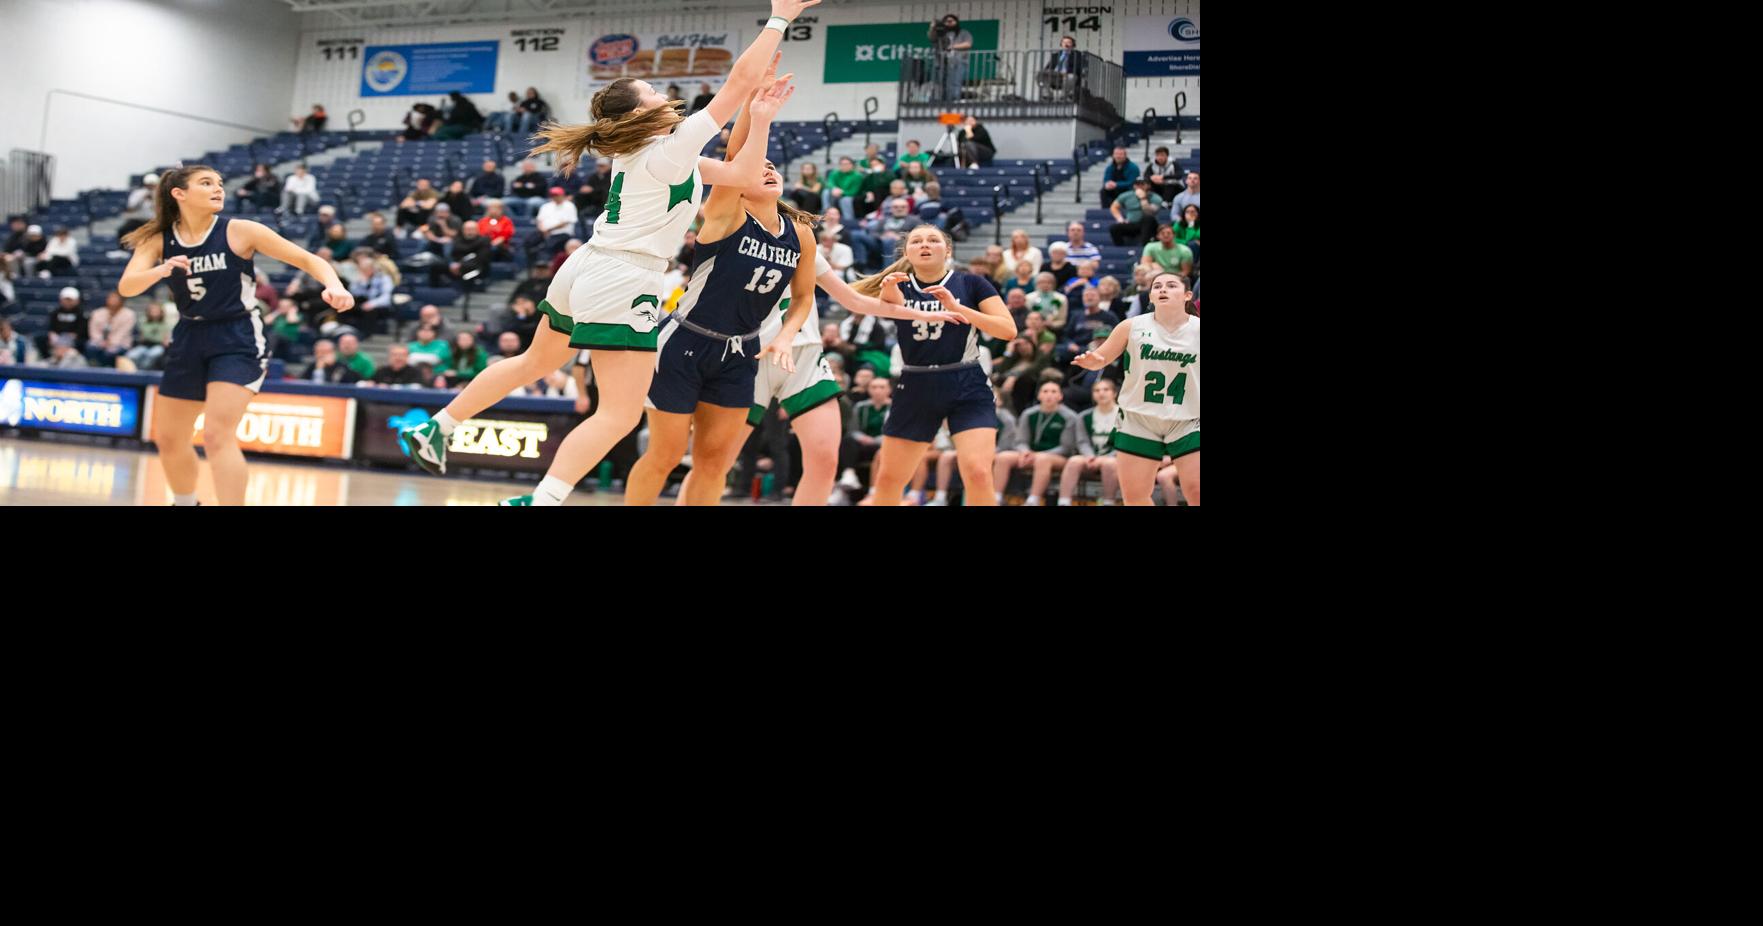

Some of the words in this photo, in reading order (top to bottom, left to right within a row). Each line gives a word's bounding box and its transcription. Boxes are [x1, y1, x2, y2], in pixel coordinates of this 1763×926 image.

[1043, 6, 1111, 15] SECTION
[511, 28, 565, 37] SECTION
[783, 25, 812, 42] 13
[1044, 16, 1101, 32] 114
[322, 46, 358, 60] 111
[514, 37, 560, 52] 112
[186, 277, 207, 301] 5
[743, 265, 783, 294] 13
[911, 319, 946, 342] 33
[1140, 343, 1197, 368] Mustangs
[1143, 370, 1187, 405] 24
[23, 396, 122, 428] NORTH
[235, 412, 324, 447] OUTH
[448, 423, 548, 458] EAST
